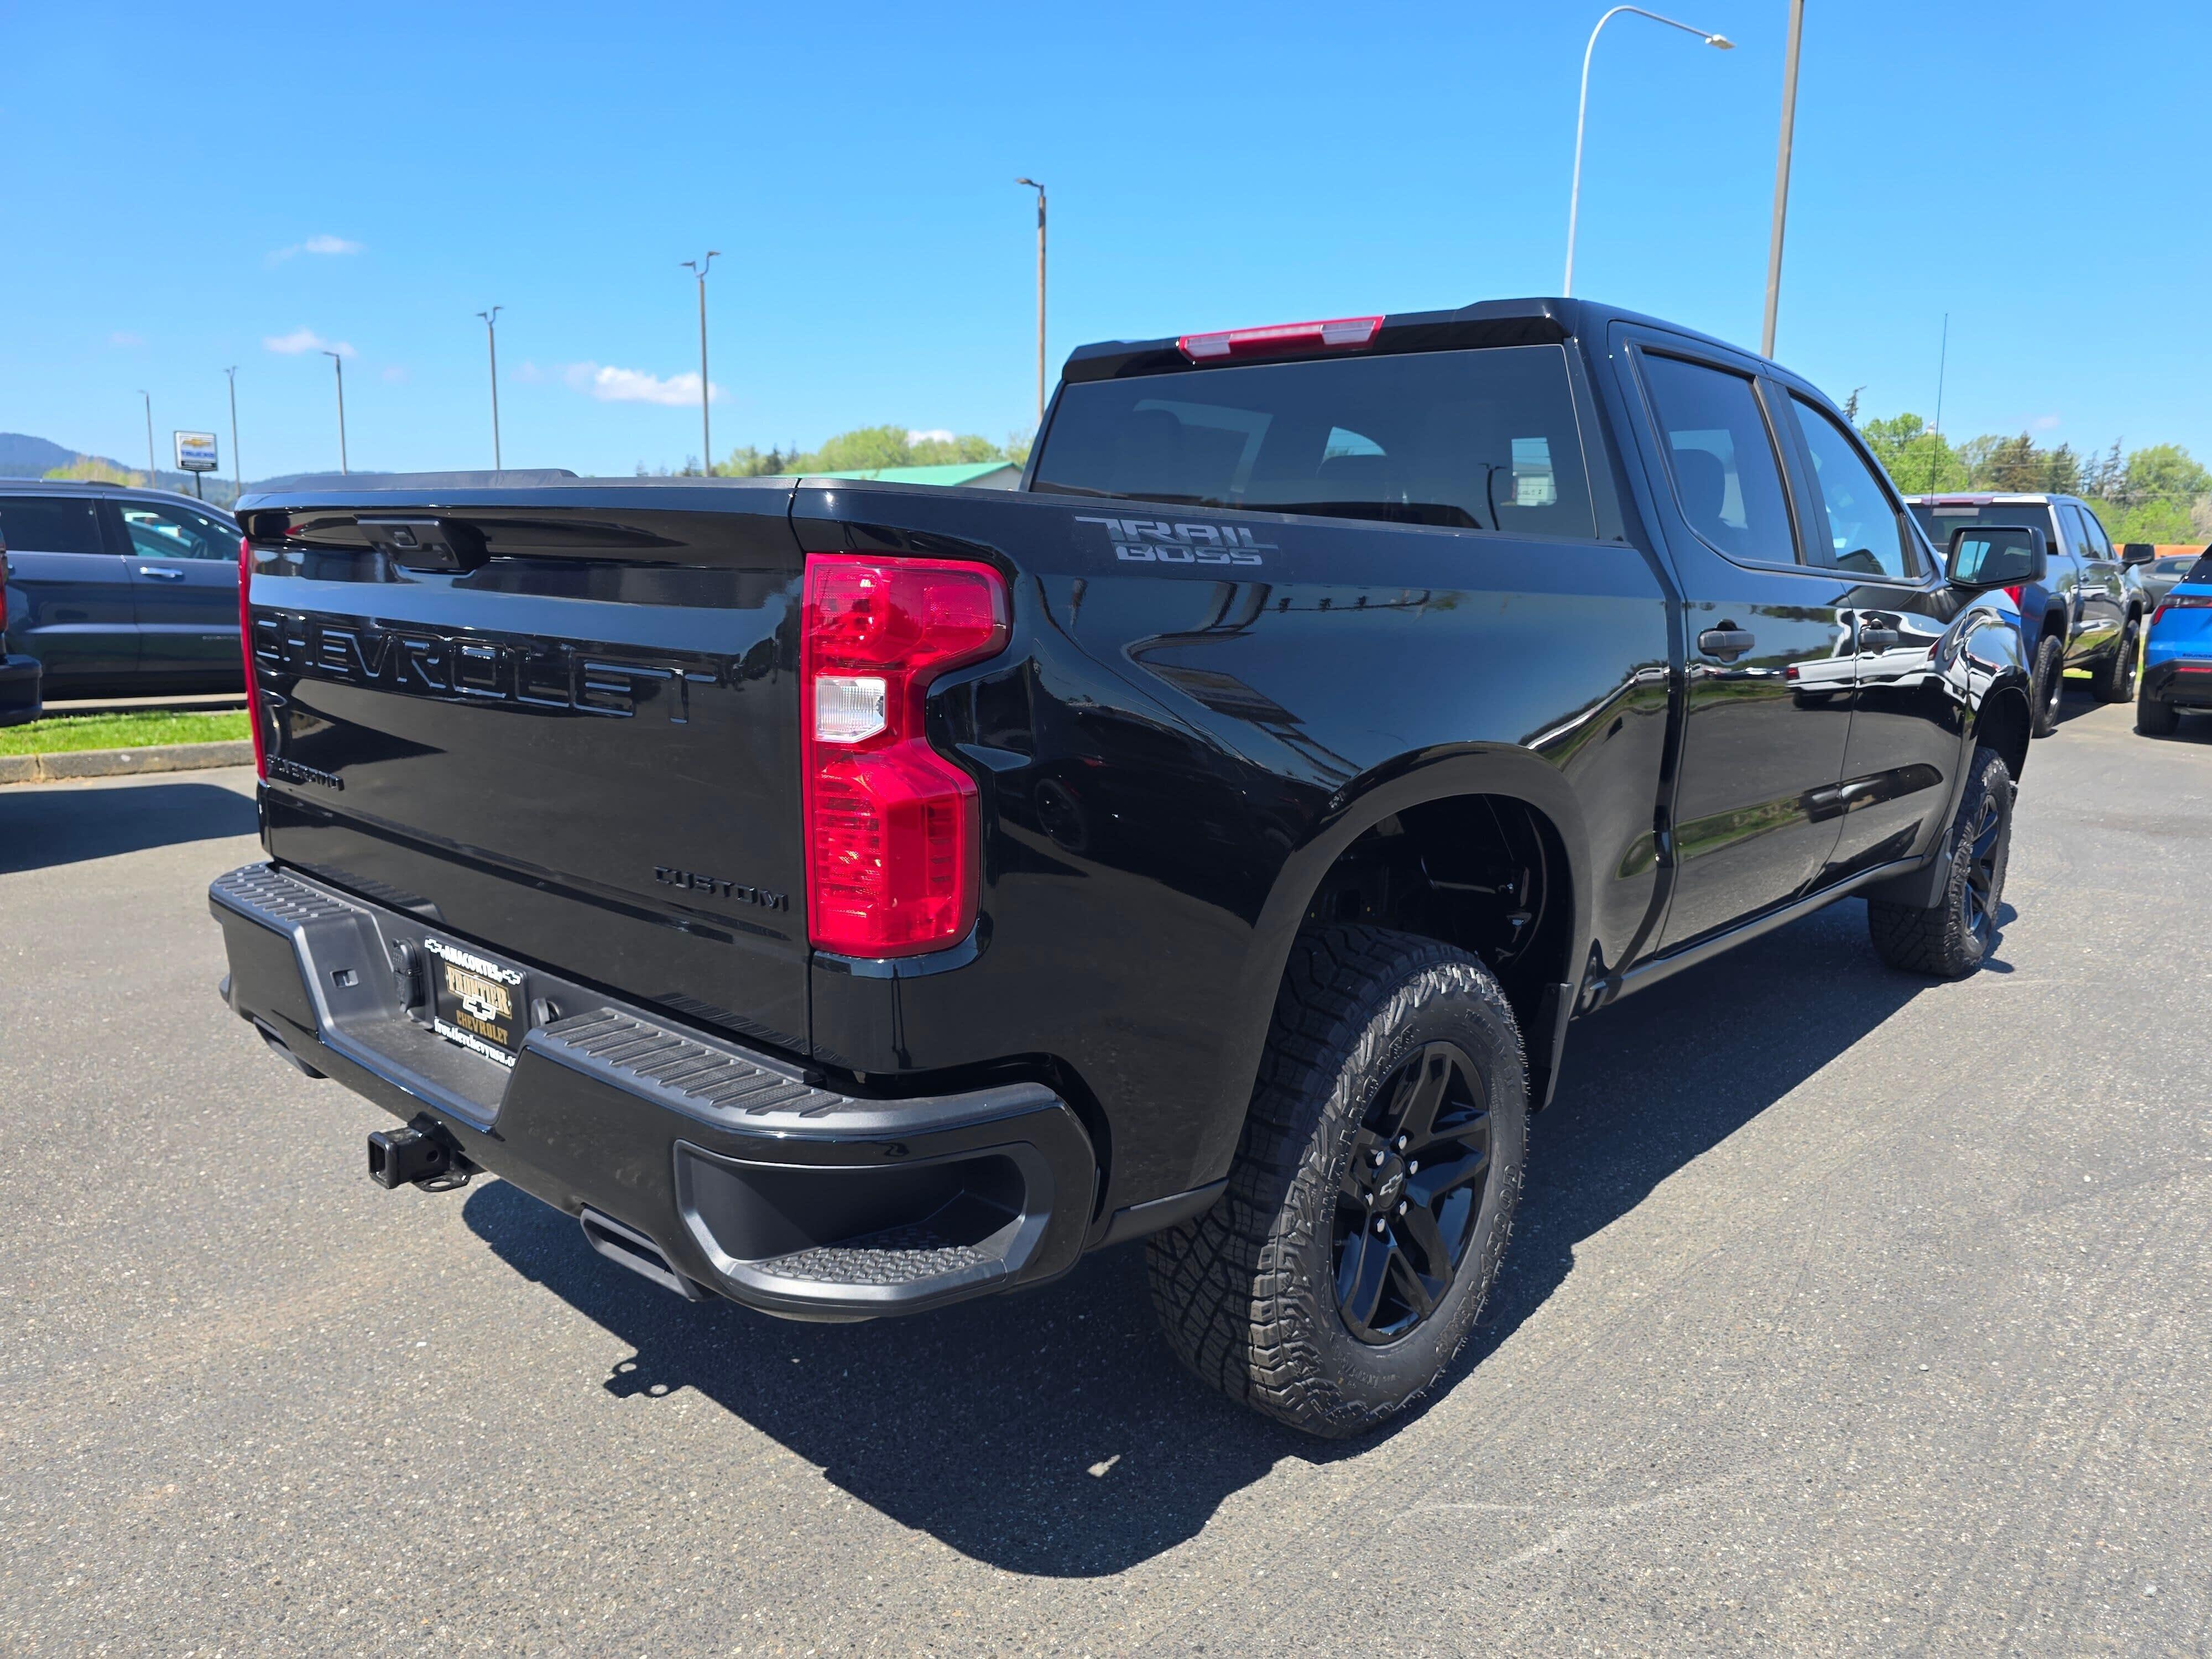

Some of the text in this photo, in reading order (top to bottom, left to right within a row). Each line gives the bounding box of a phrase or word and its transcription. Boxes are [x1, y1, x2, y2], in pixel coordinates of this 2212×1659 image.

[1073, 514, 1279, 550] TRAIL
[1113, 541, 1263, 566] BOSS
[255, 611, 718, 724] CHEVROLET
[654, 866, 789, 912] CUSTOM
[444, 945, 499, 981] ANACORTES
[447, 966, 512, 1016] FRONTIER
[456, 1010, 508, 1046] CHEVROLET
[1433, 1163, 1518, 1367] GOODYEAR
